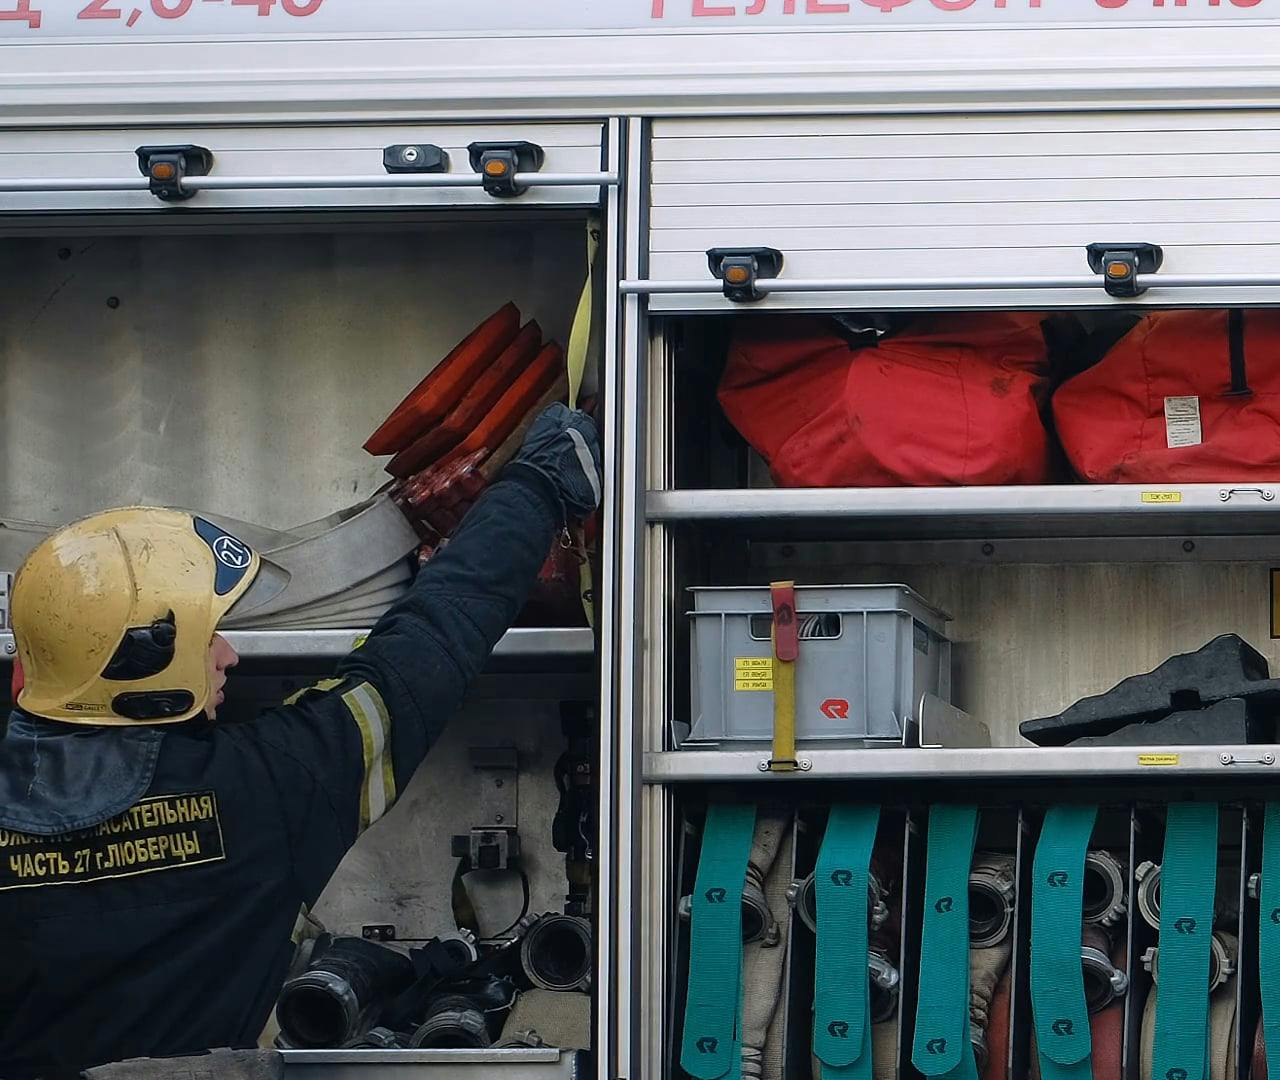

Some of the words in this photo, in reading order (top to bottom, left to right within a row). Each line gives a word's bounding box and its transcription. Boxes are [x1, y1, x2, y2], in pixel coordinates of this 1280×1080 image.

[221, 539, 244, 566] 27
[9, 852, 71, 878] ЧАСТЬ
[74, 848, 91, 874] 27
